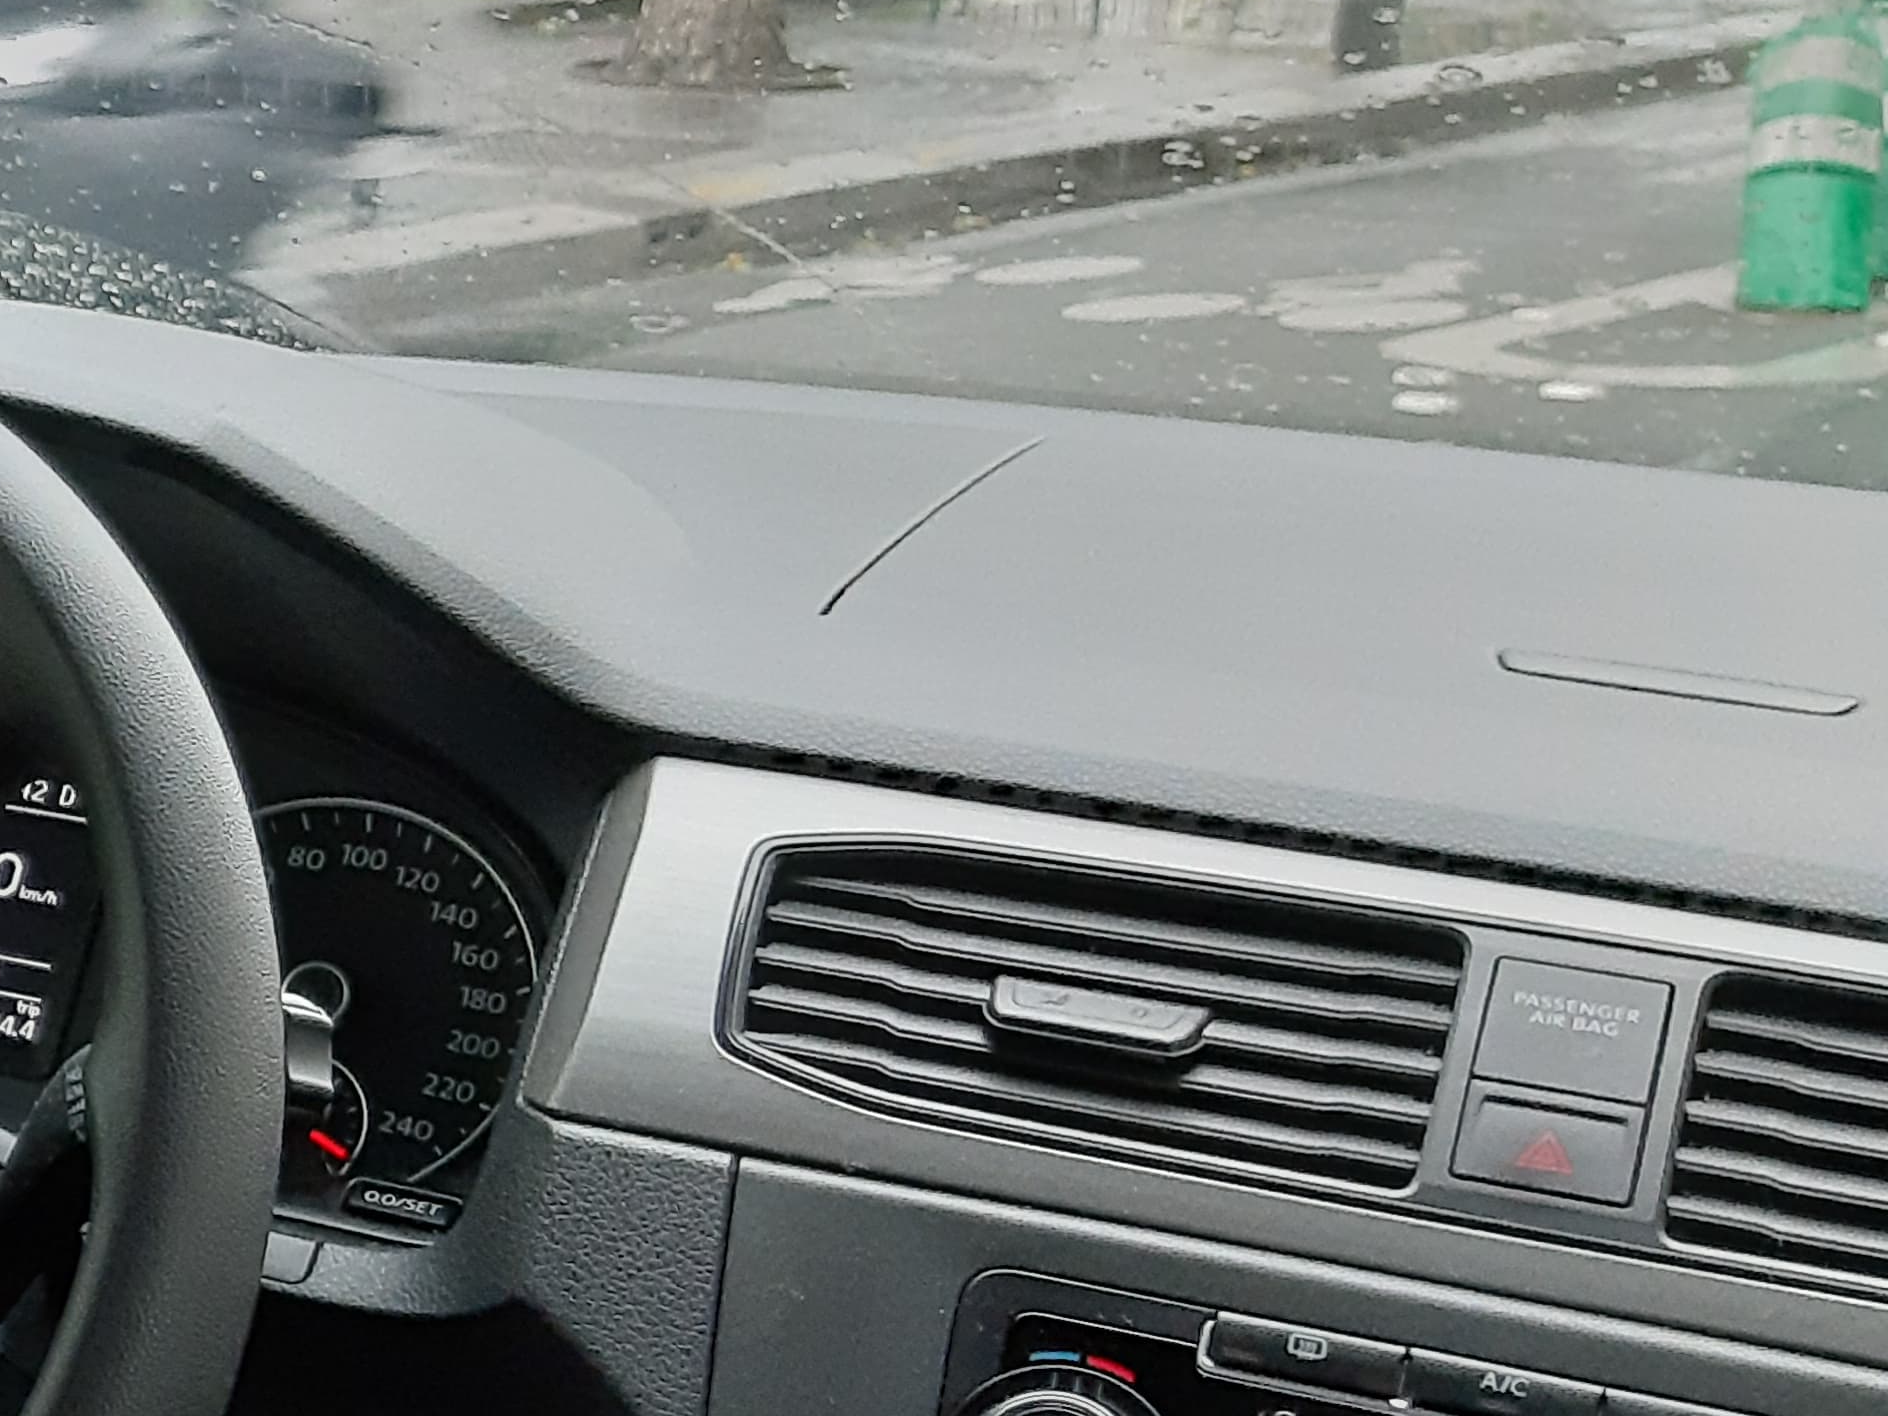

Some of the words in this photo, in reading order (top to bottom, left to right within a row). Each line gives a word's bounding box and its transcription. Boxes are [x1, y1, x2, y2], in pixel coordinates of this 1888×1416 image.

[286, 845, 325, 870] 80
[341, 843, 388, 871] 100
[394, 865, 440, 893] 120
[18, 885, 58, 906] km/h
[430, 901, 478, 930] 140
[452, 940, 499, 971] 160
[16, 999, 42, 1017] trip
[460, 986, 507, 1014] 180
[1513, 991, 1641, 1024] PASSENGER
[1528, 1010, 1566, 1028] AIR
[1571, 1016, 1620, 1038] BAG
[445, 1029, 501, 1059] 200
[421, 1071, 476, 1104] 220
[377, 1110, 435, 1141] 240
[1479, 1370, 1530, 1398] A/C
